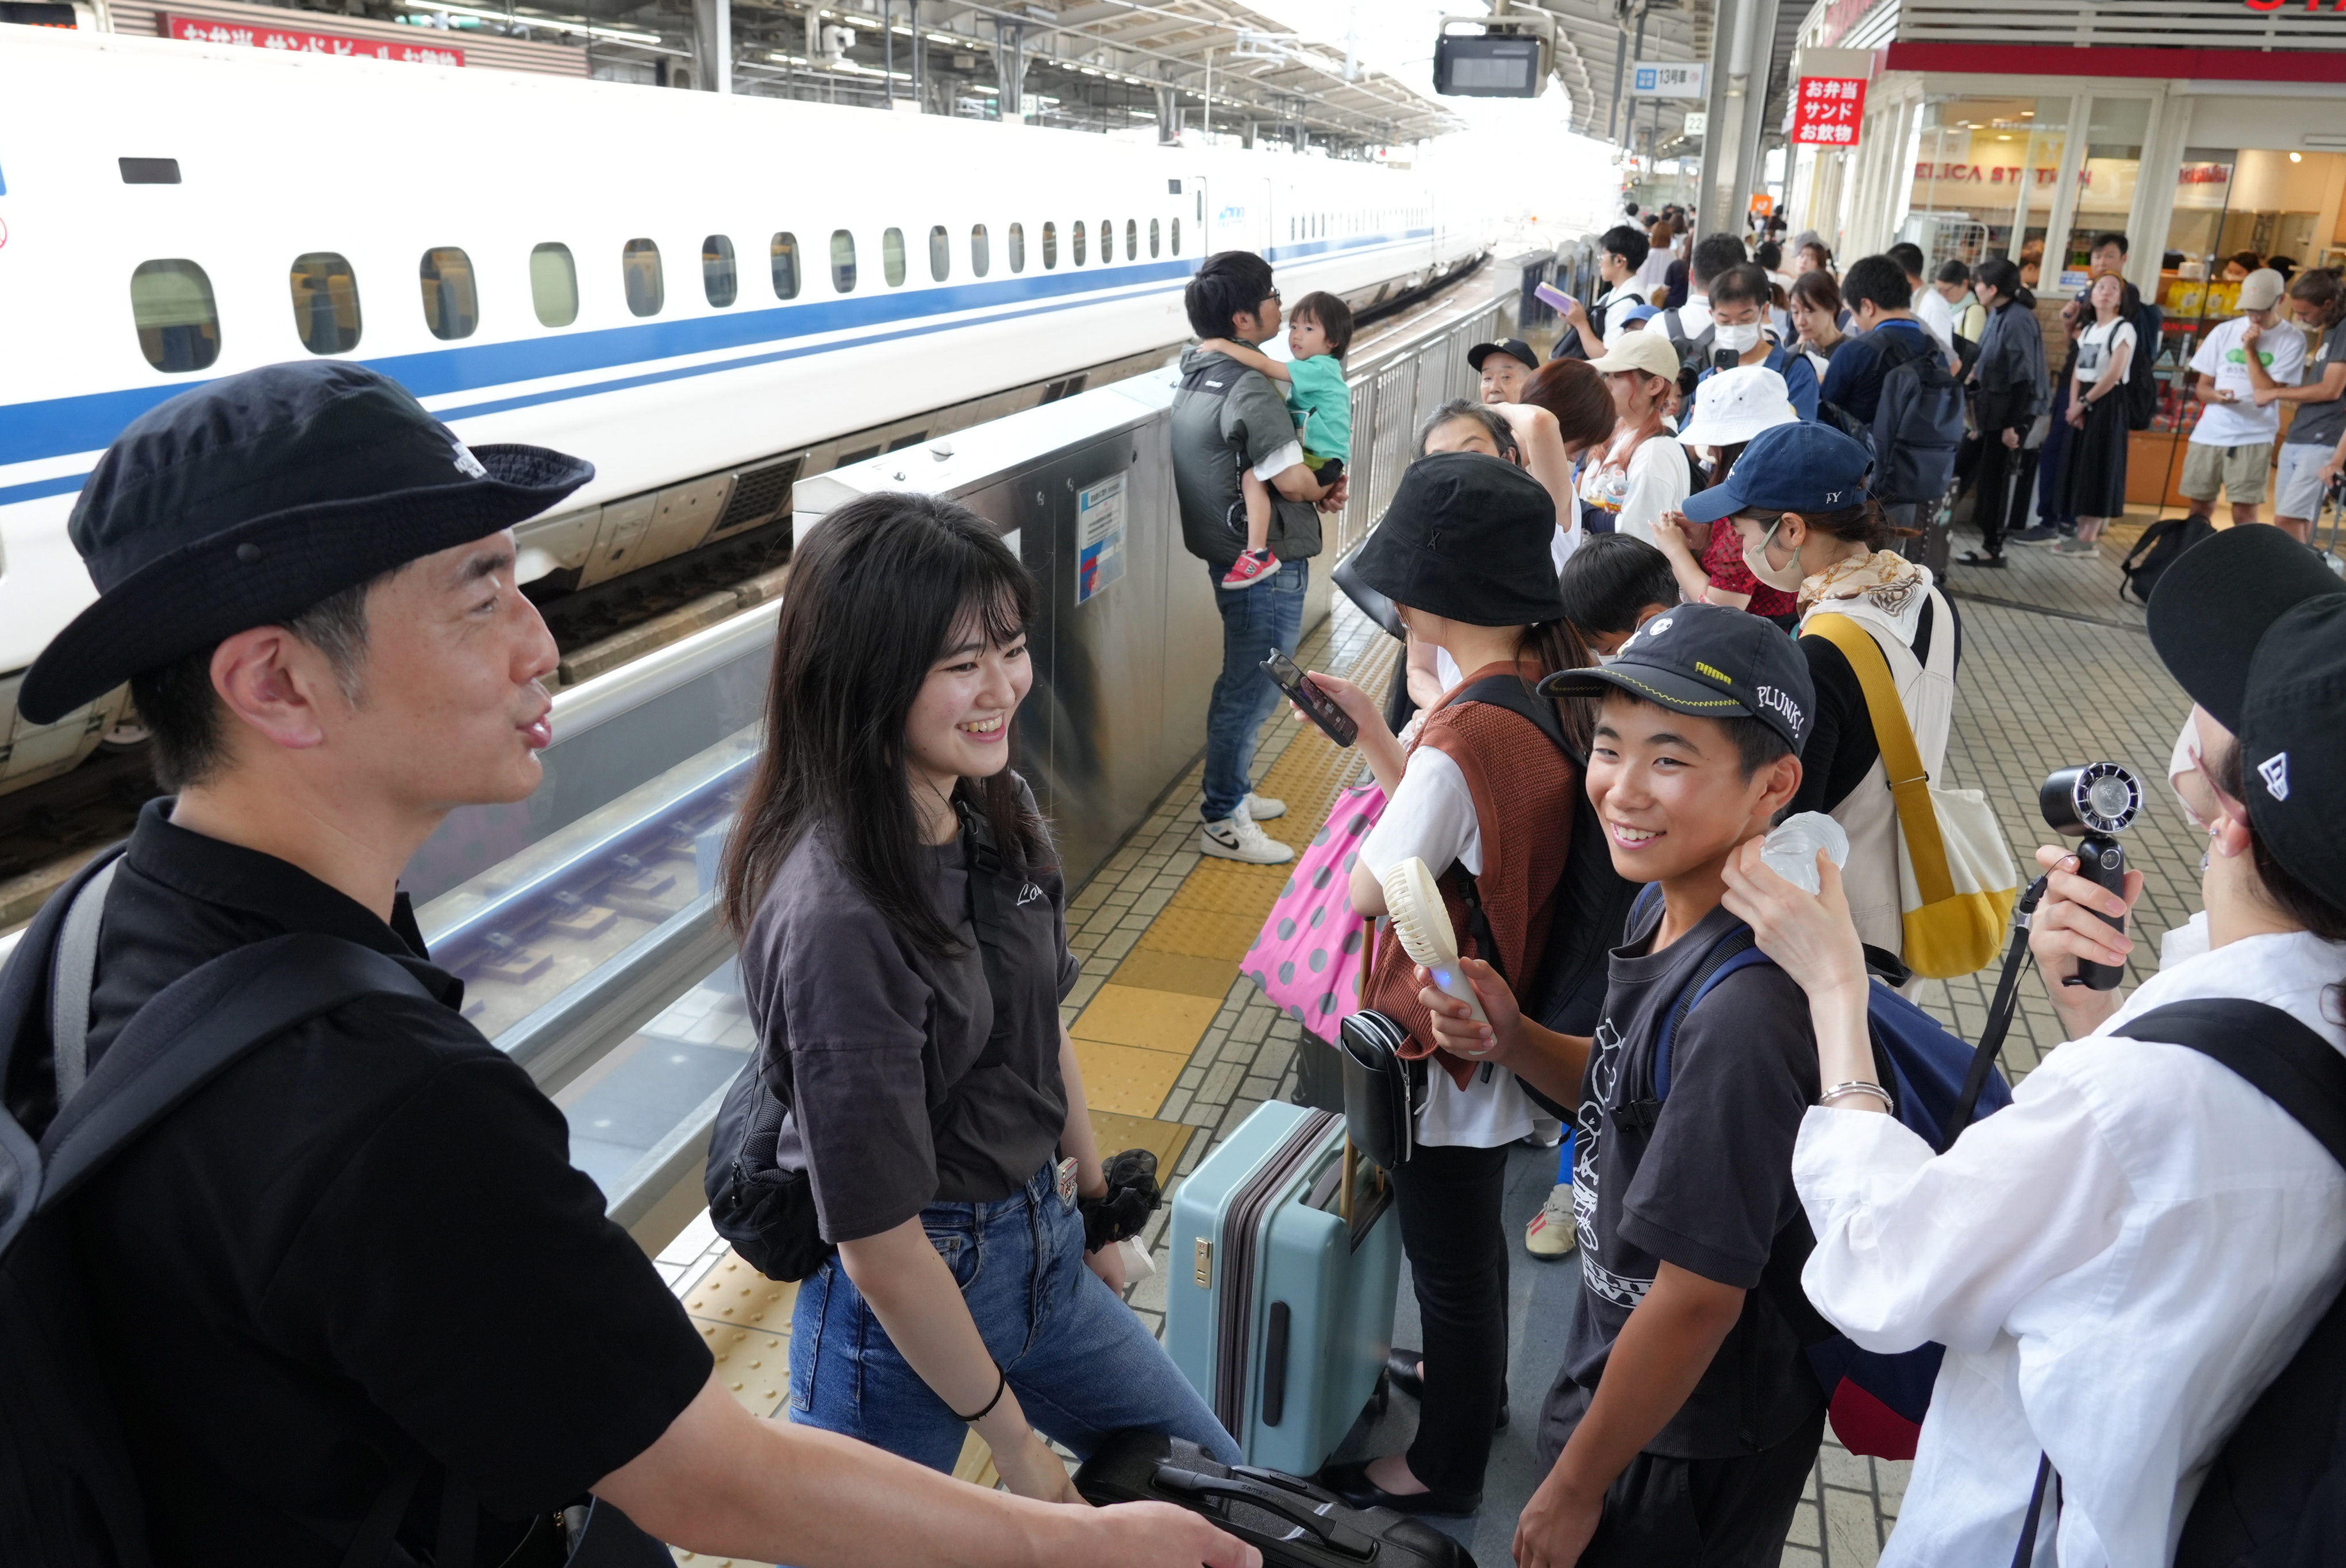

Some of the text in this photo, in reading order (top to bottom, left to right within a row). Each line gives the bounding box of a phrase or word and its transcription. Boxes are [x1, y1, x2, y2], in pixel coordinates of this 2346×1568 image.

[1806, 80, 1858, 99] お弁当
[1804, 101, 1853, 121] サンド
[1688, 117, 1703, 129] 22
[1800, 123, 1852, 142] お飲物
[1757, 685, 1805, 739] PLUNK!
[1240, 1484, 1284, 1504] Samsonite
